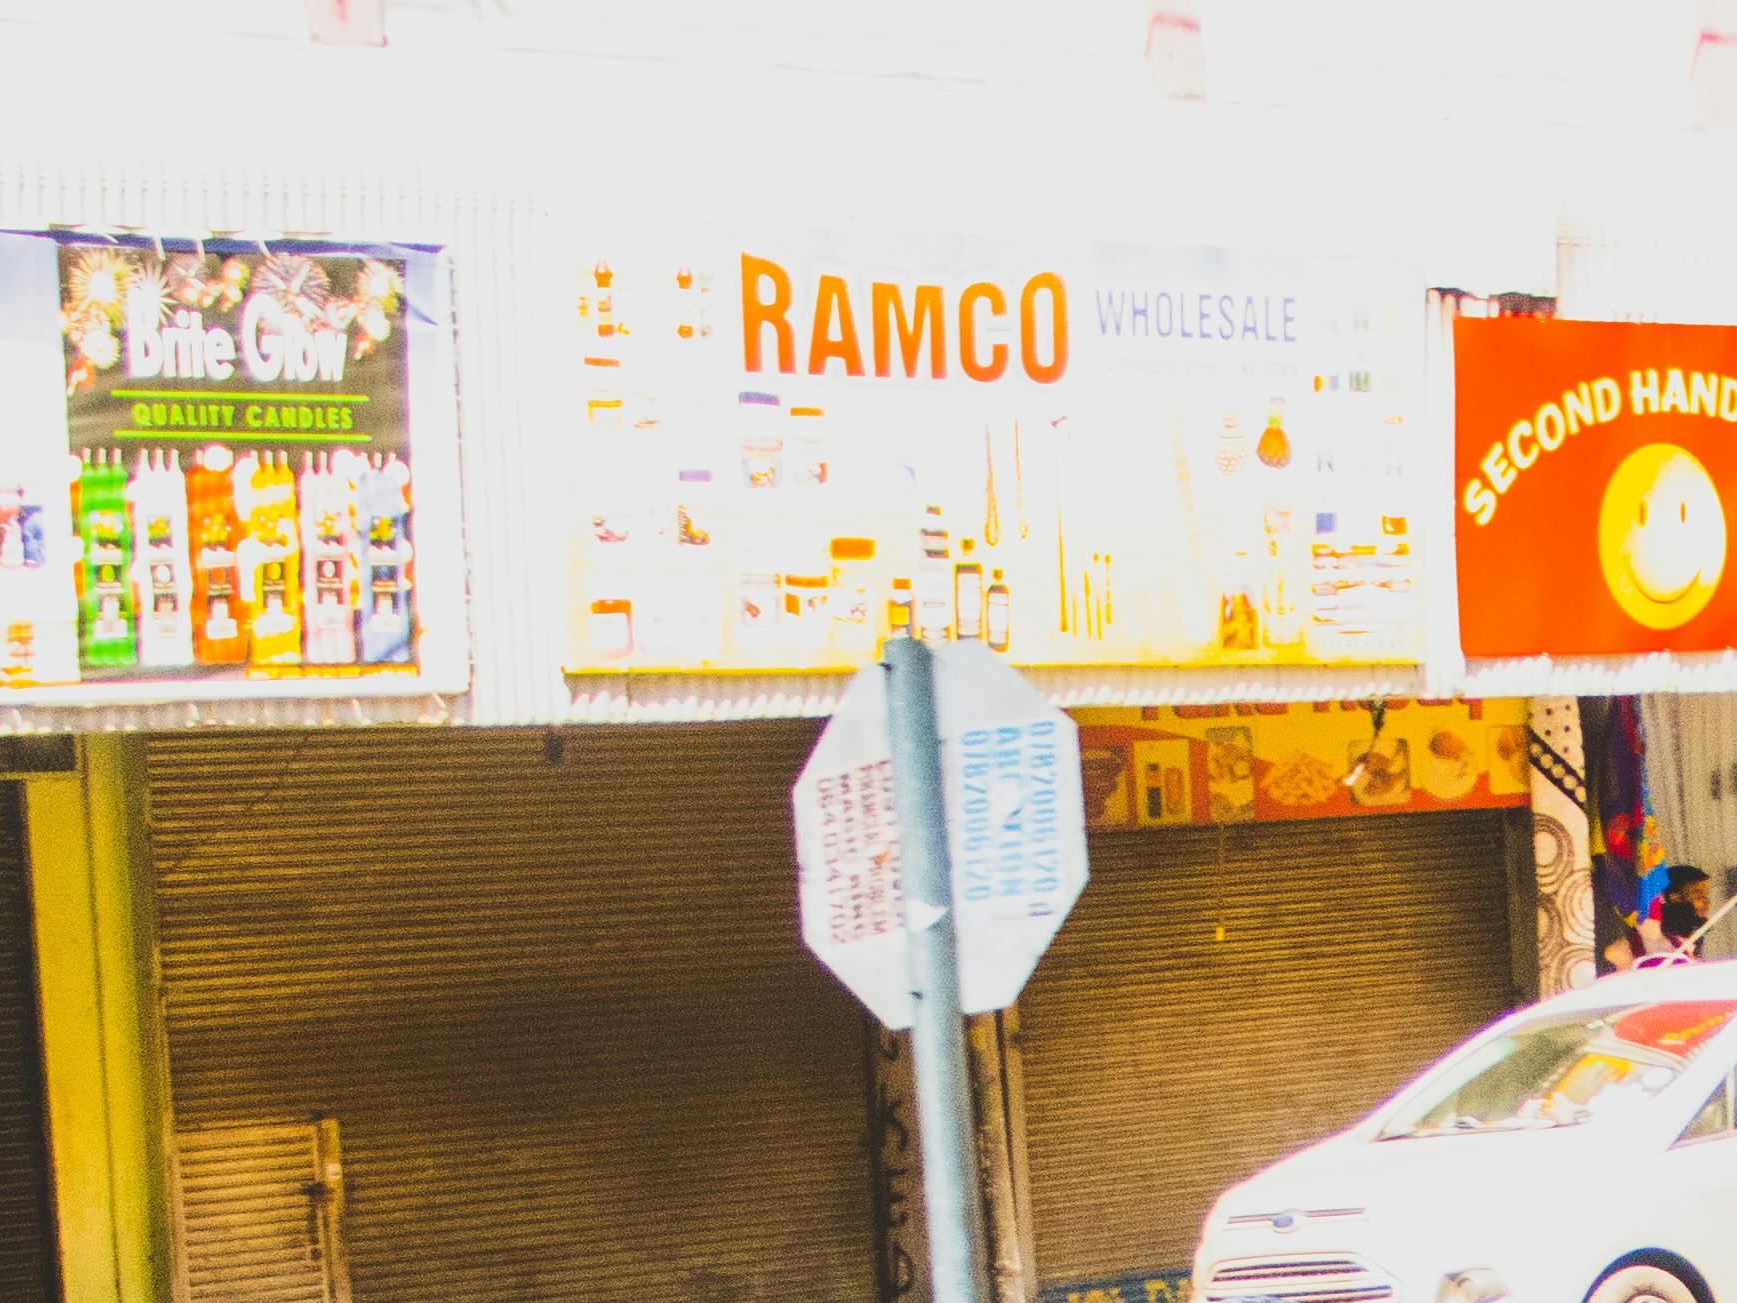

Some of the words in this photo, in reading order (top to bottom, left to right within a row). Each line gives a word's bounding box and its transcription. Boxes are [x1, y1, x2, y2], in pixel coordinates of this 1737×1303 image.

[127, 289, 233, 380] Brite
[240, 289, 348, 383] Glow
[740, 252, 1070, 385] RAMCO
[1096, 289, 1296, 342] WHOLESALE
[131, 402, 237, 430] QUALITY
[244, 404, 354, 432] CANDLES
[1465, 375, 1622, 527] SECOND
